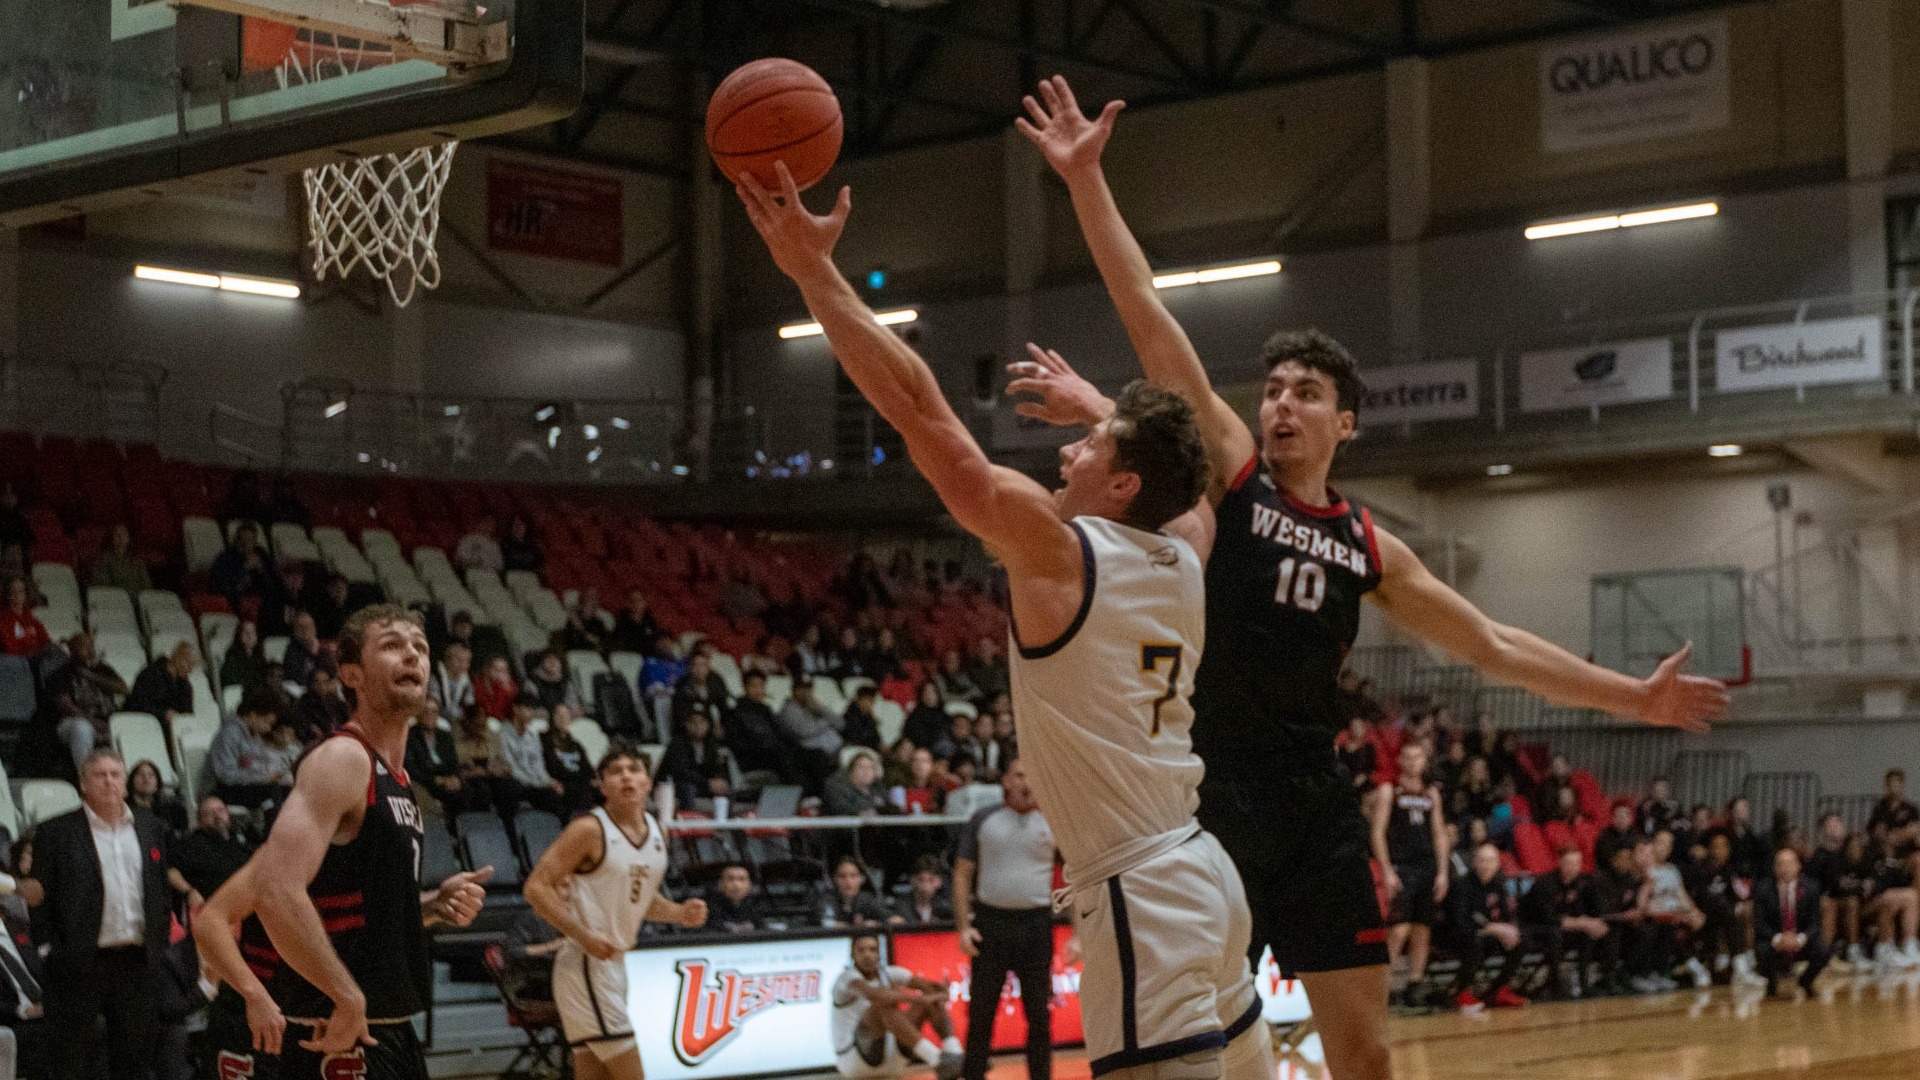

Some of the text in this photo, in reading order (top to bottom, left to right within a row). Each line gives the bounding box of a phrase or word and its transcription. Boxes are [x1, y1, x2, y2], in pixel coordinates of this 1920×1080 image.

[1549, 33, 1714, 93] QUALICO
[1729, 333, 1866, 373] Birchwood
[1365, 380, 1468, 410] exterra
[1250, 501, 1368, 579] WESMEN
[1273, 557, 1328, 614] 10
[1140, 641, 1183, 737] 7
